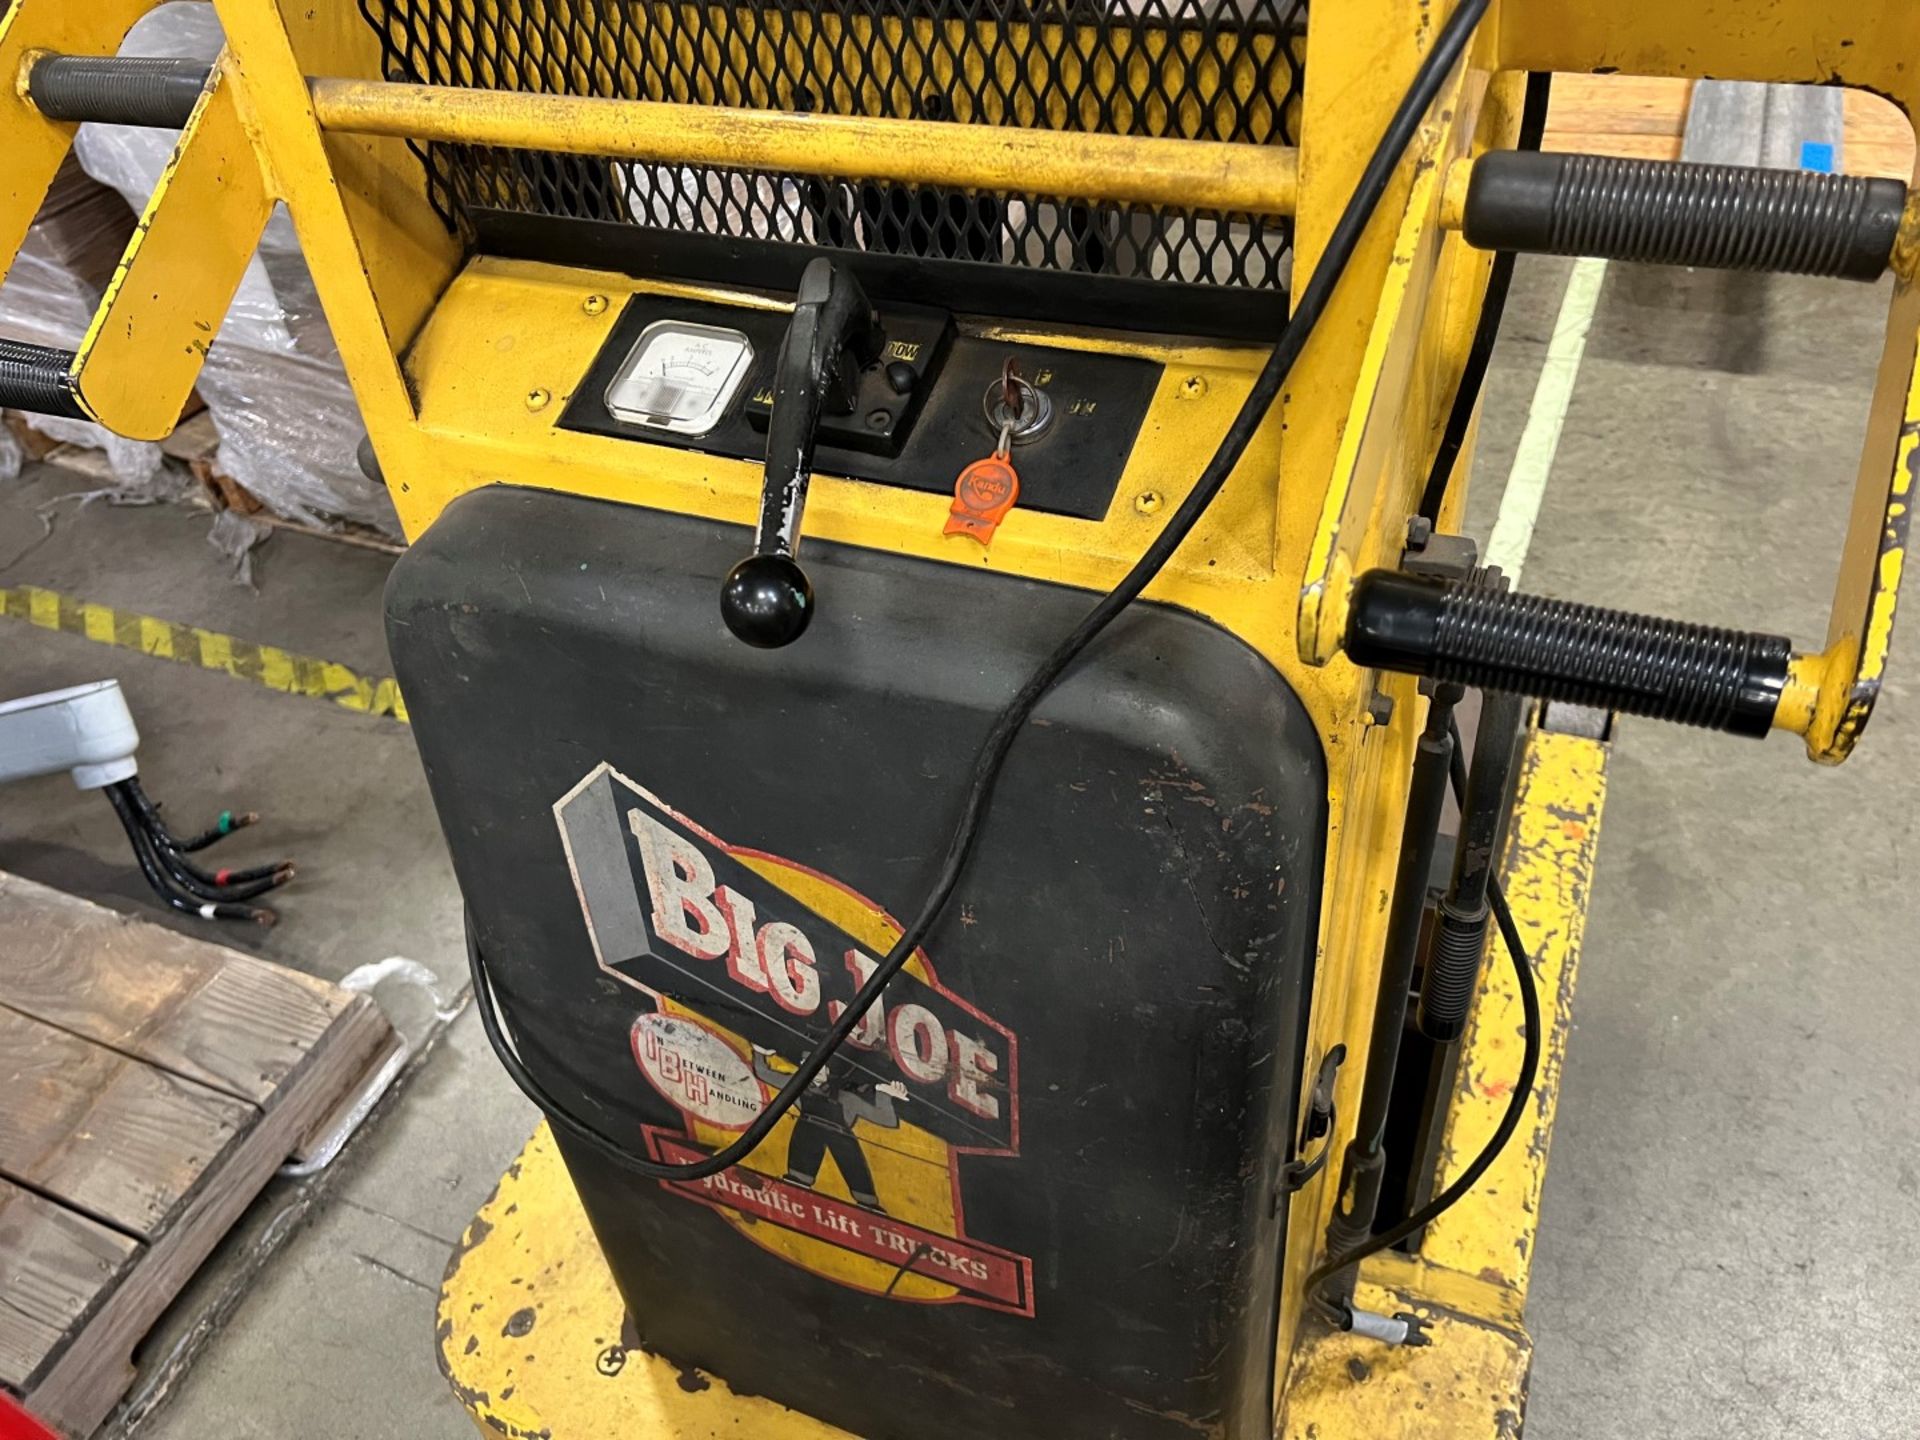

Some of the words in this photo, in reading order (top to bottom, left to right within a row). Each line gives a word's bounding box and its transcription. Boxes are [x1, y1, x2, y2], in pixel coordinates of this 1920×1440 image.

[627, 808, 821, 1016] BIG
[828, 949, 999, 1119] JOE
[659, 1047, 726, 1083] BETWEEN
[685, 1071, 757, 1112] HANDLING
[679, 1157, 805, 1218] ydraulic
[812, 1204, 862, 1238] Lift
